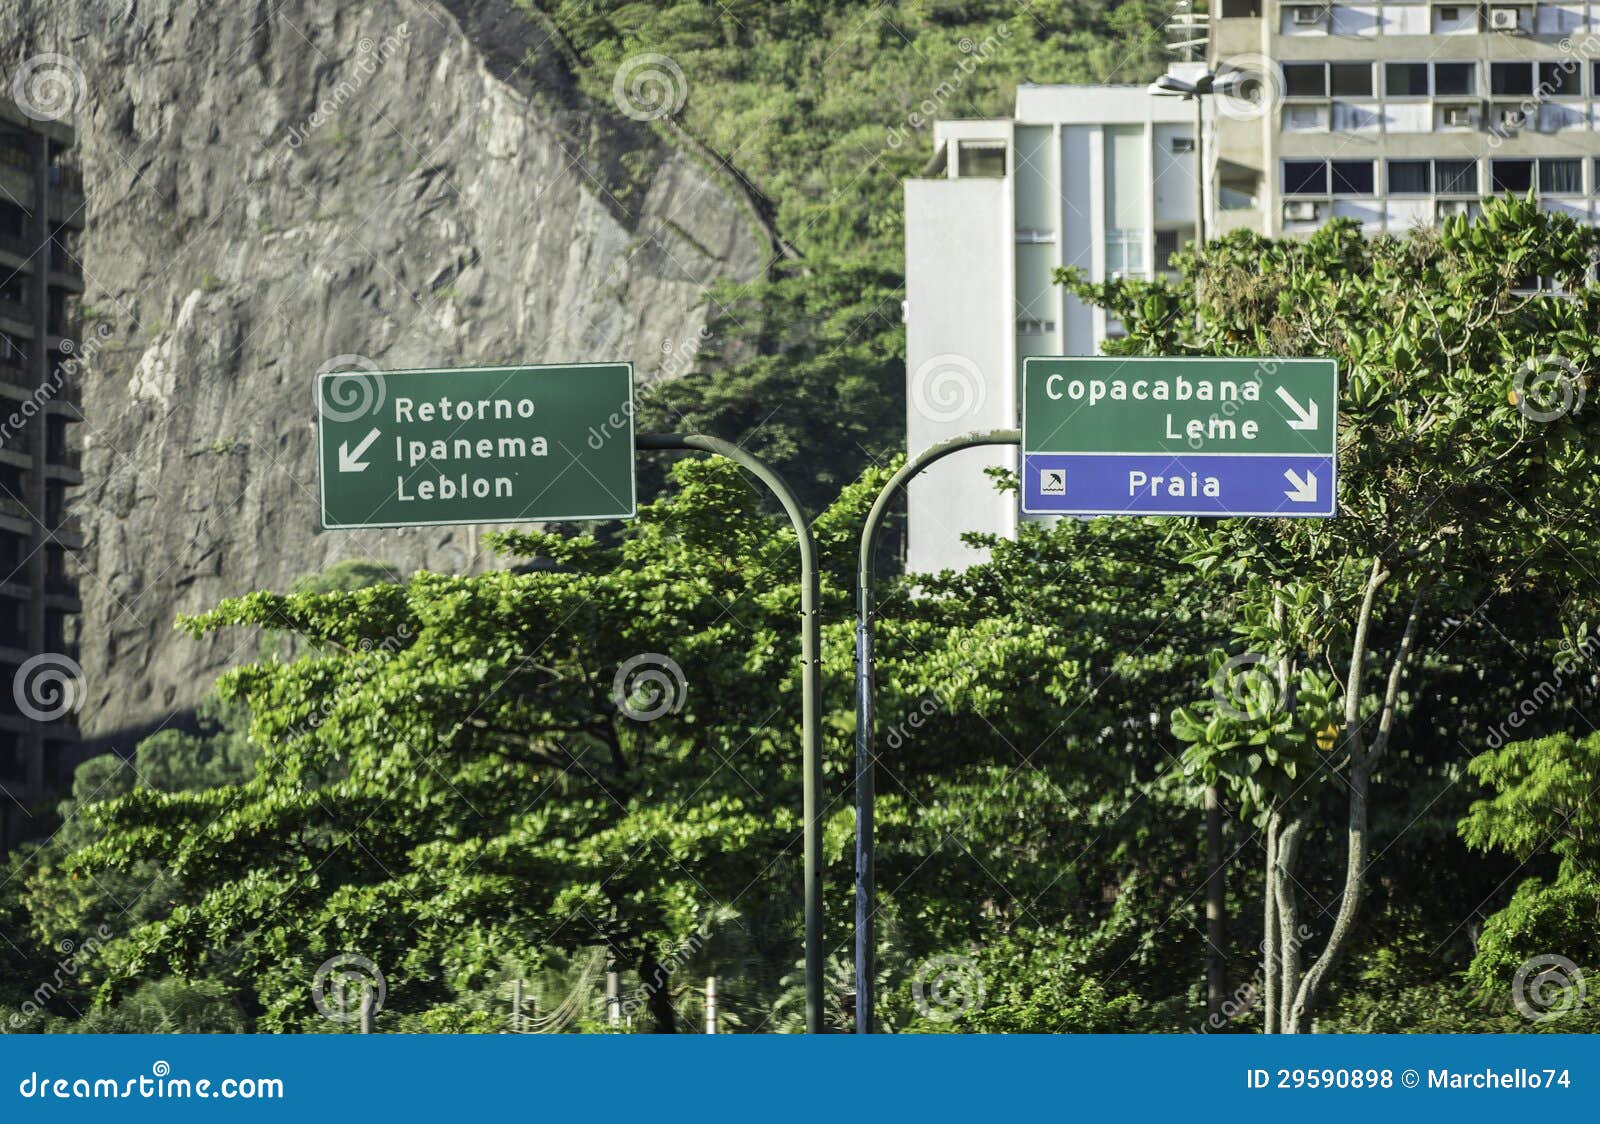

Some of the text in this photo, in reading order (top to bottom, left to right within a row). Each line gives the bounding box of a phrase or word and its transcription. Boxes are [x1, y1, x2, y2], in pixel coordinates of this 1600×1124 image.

[1045, 373, 1260, 406] Copacabana
[395, 396, 535, 423] Retorno
[1165, 413, 1259, 440] Leme
[396, 436, 548, 468] Ipanema
[397, 473, 513, 501] Leblon
[1129, 470, 1220, 497] Praia
